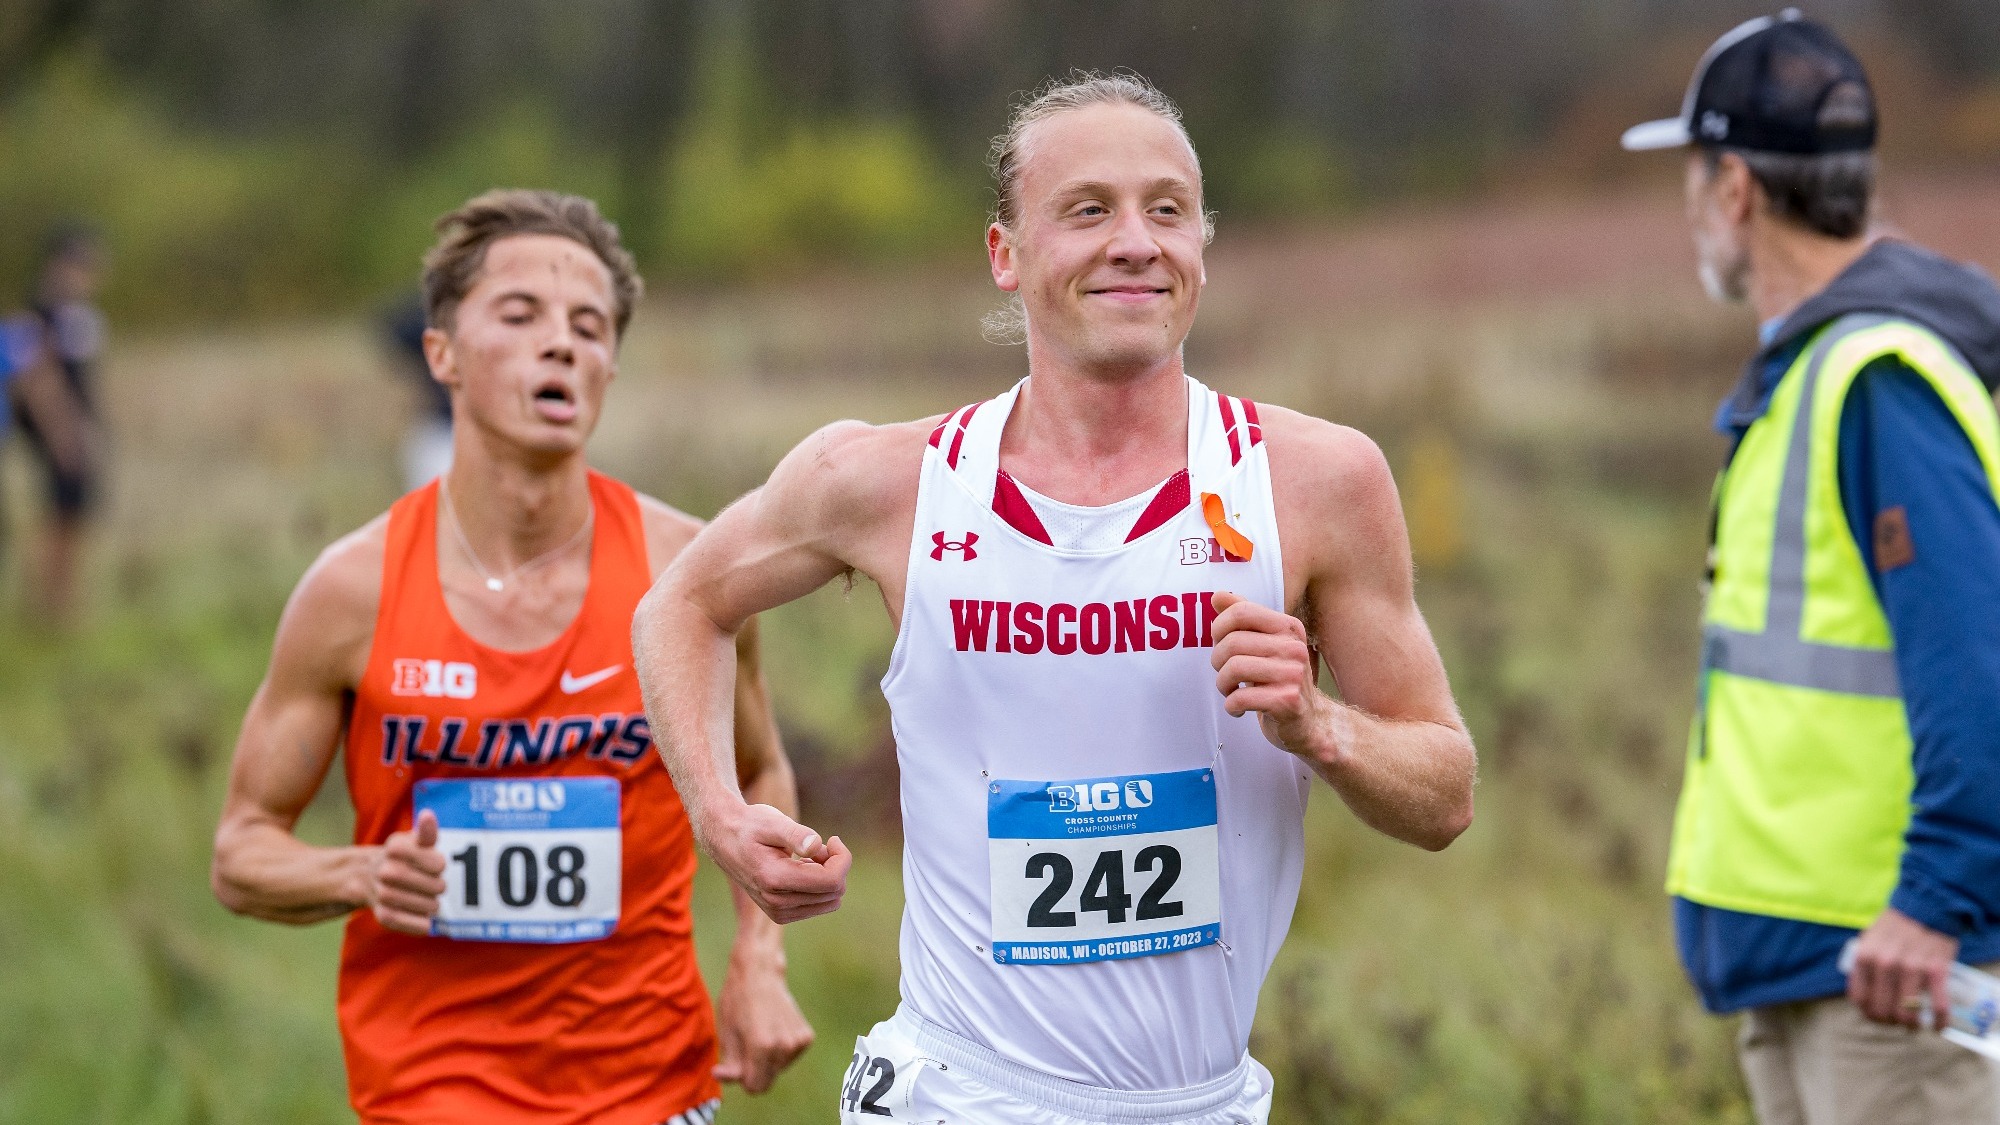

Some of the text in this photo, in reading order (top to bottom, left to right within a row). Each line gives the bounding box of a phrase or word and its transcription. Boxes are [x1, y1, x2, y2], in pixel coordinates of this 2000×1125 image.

[382, 714, 652, 768] ILLINOIS
[1065, 813, 1139, 825] CROSS COUNTRY
[1067, 823, 1137, 834] CHAMPIONSHIPS
[452, 845, 586, 908] 108
[1025, 844, 1183, 928] 242
[1011, 931, 1202, 960] MADISON, WI OCTOBER 27, 2023
